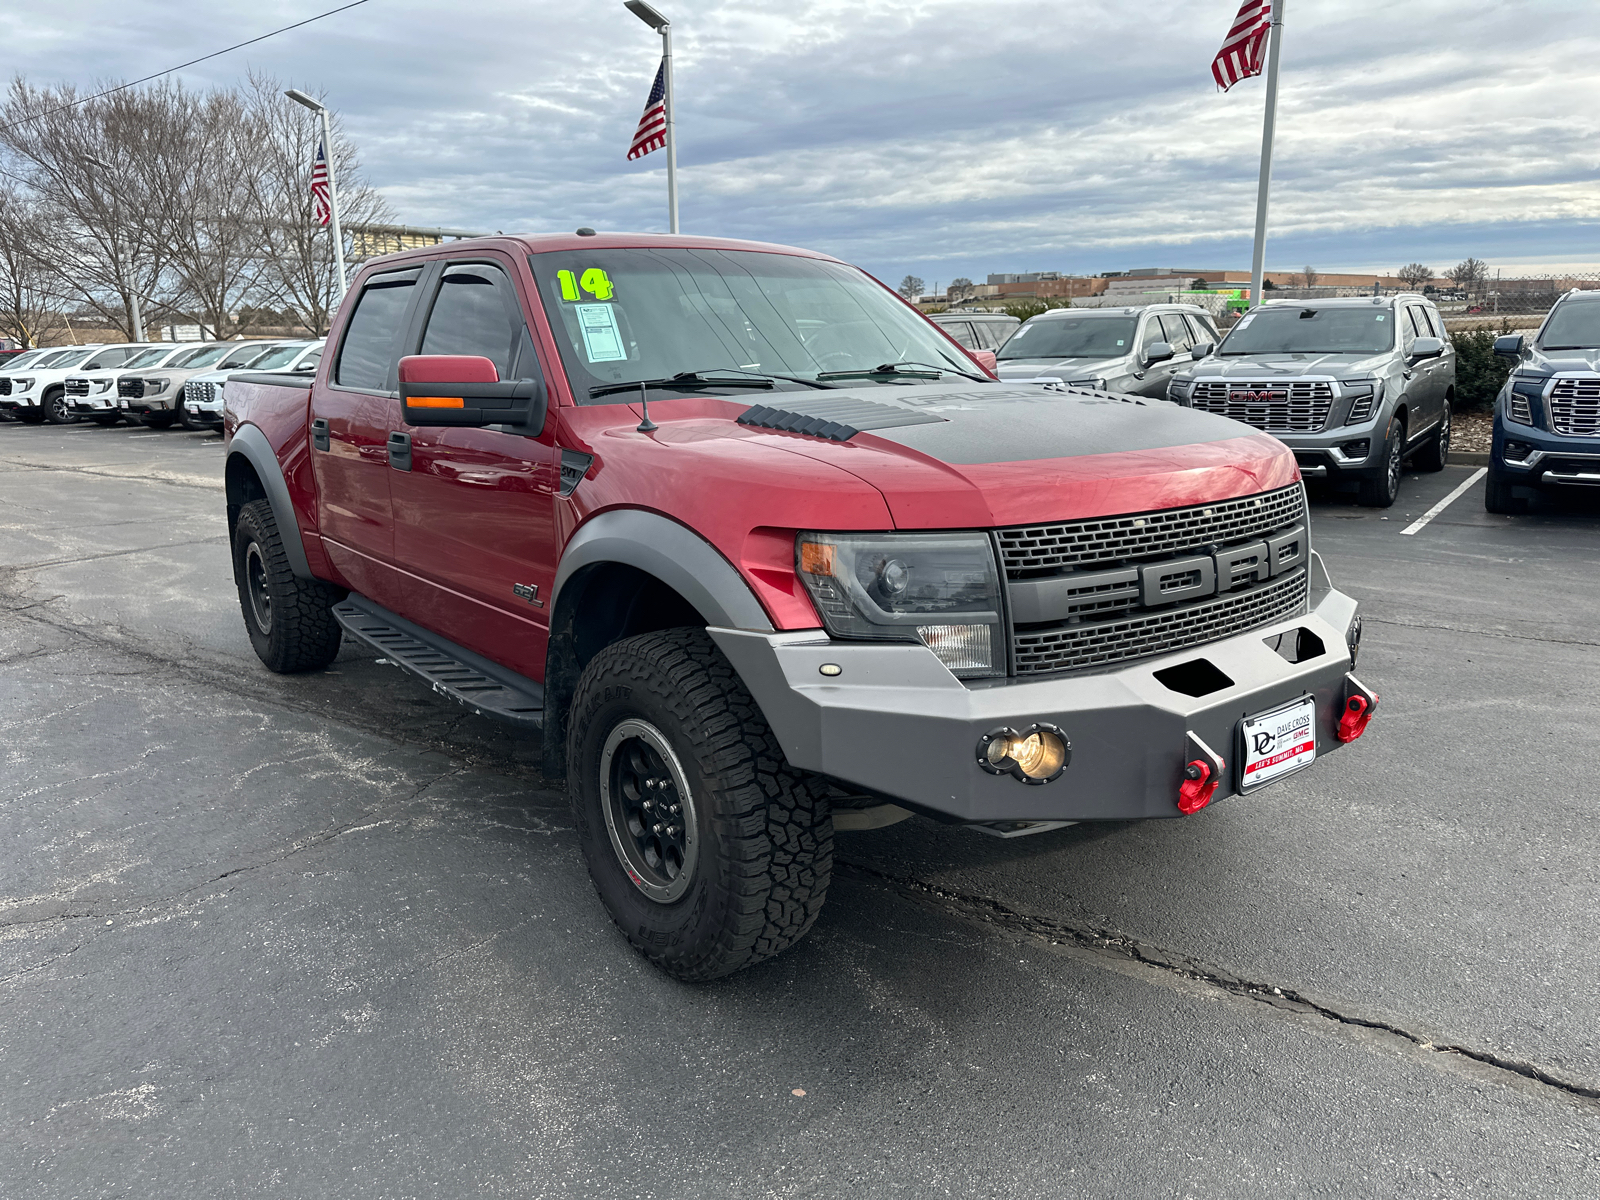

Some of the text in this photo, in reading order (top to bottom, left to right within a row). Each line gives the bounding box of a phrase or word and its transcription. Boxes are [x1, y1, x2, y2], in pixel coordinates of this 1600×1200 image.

[557, 268, 614, 301] 14
[1230, 390, 1287, 402] GMC
[561, 466, 577, 479] SVT
[1008, 525, 1305, 623] FORD
[1277, 714, 1310, 735] DAVE CROSS
[1293, 728, 1310, 740] GMC
[1255, 758, 1271, 769] LEE'S
[1295, 745, 1304, 753] MO
